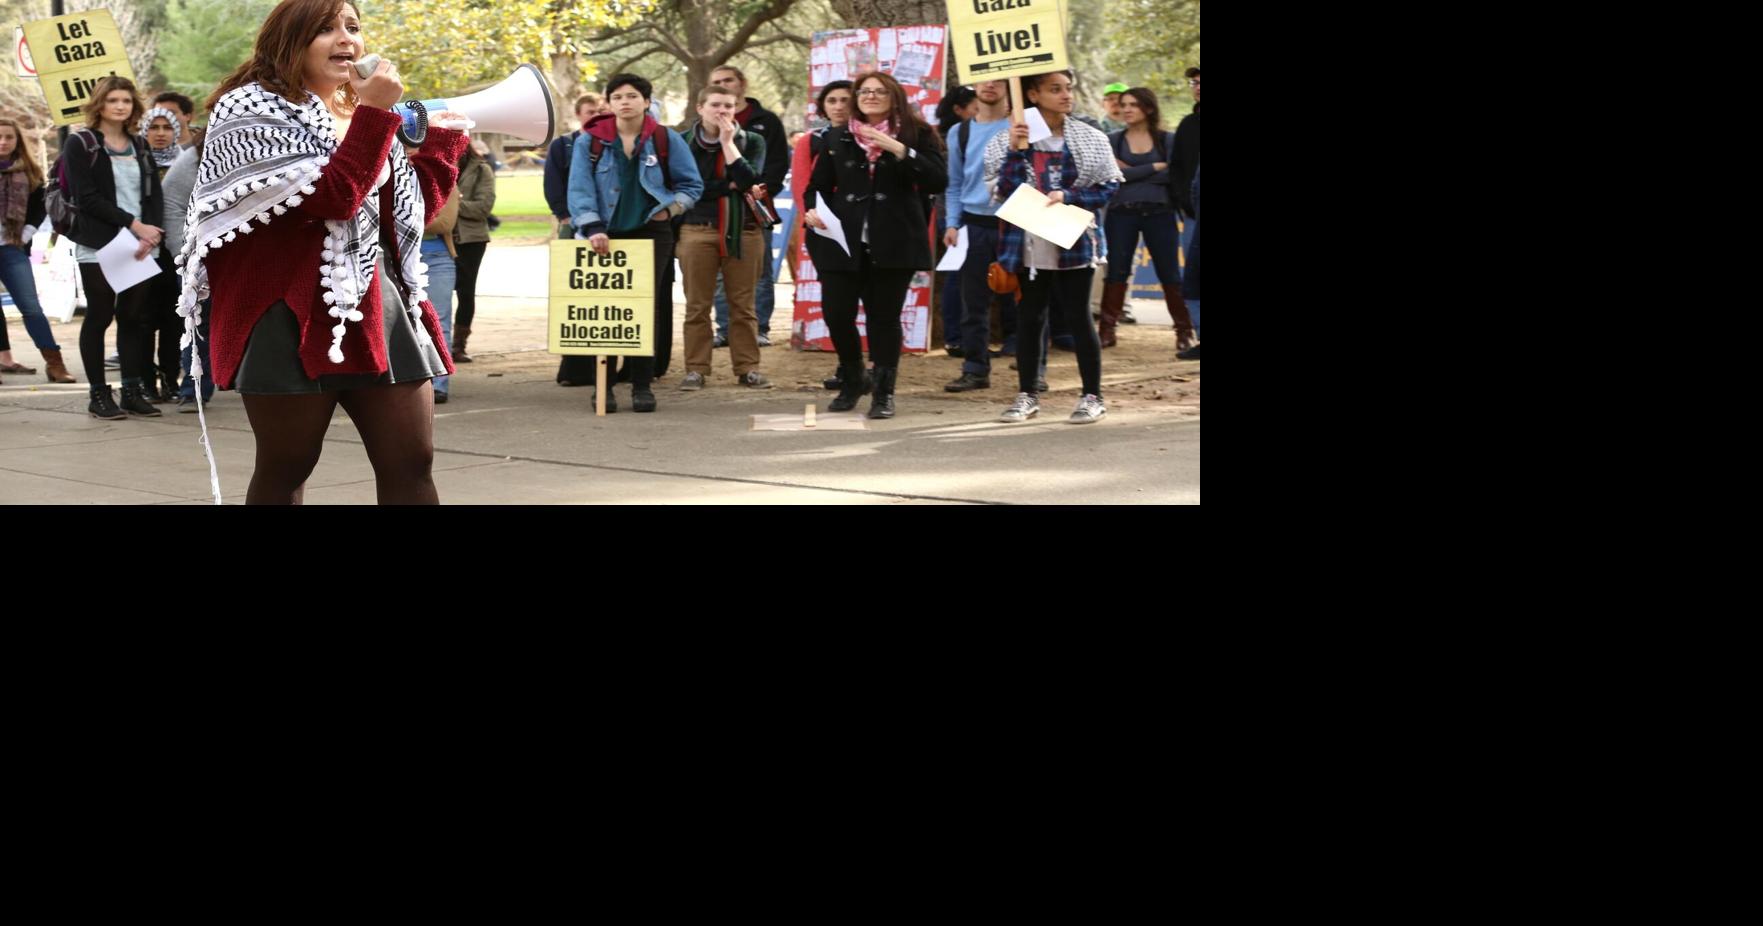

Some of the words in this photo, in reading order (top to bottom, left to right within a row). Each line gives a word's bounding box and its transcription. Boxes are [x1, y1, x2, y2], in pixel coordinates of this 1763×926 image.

[57, 20, 92, 41] Let
[974, 24, 1042, 56] Live!
[54, 41, 106, 64] Gaza
[576, 247, 627, 267] Free
[569, 269, 633, 290] Gaza!
[568, 305, 599, 321] End
[604, 305, 634, 321] the
[560, 323, 641, 339] blocade!
